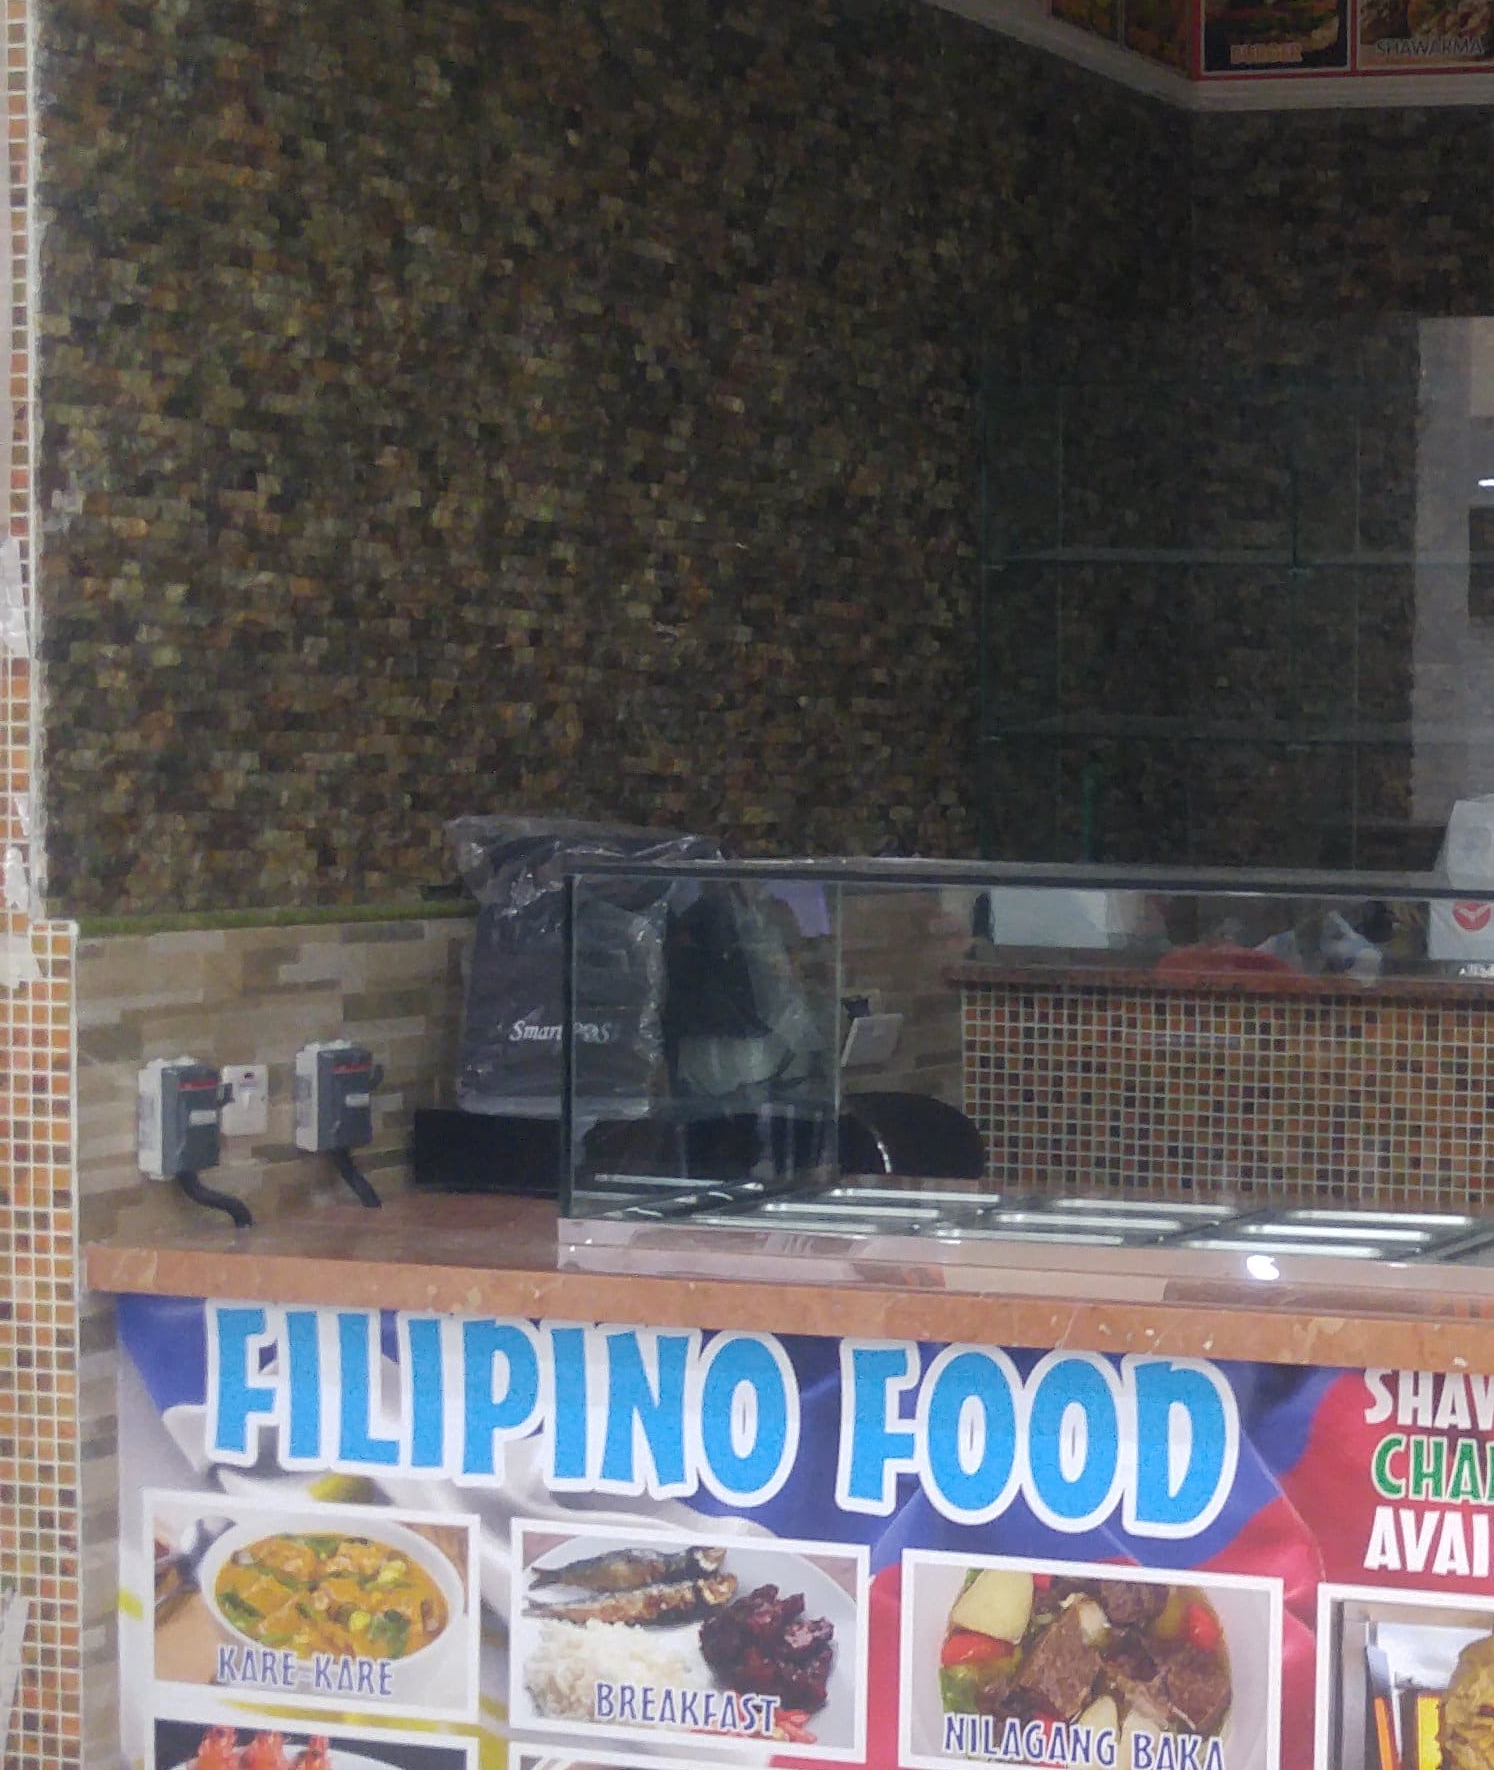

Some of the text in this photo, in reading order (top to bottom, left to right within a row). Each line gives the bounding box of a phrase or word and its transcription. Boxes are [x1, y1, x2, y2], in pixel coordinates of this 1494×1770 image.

[1374, 37, 1485, 58] SHAWARMA
[204, 1301, 1240, 1539] FILIPINO FOOD
[594, 1682, 782, 1737] BREAKFAST
[942, 1713, 1117, 1770] NILAGANG
